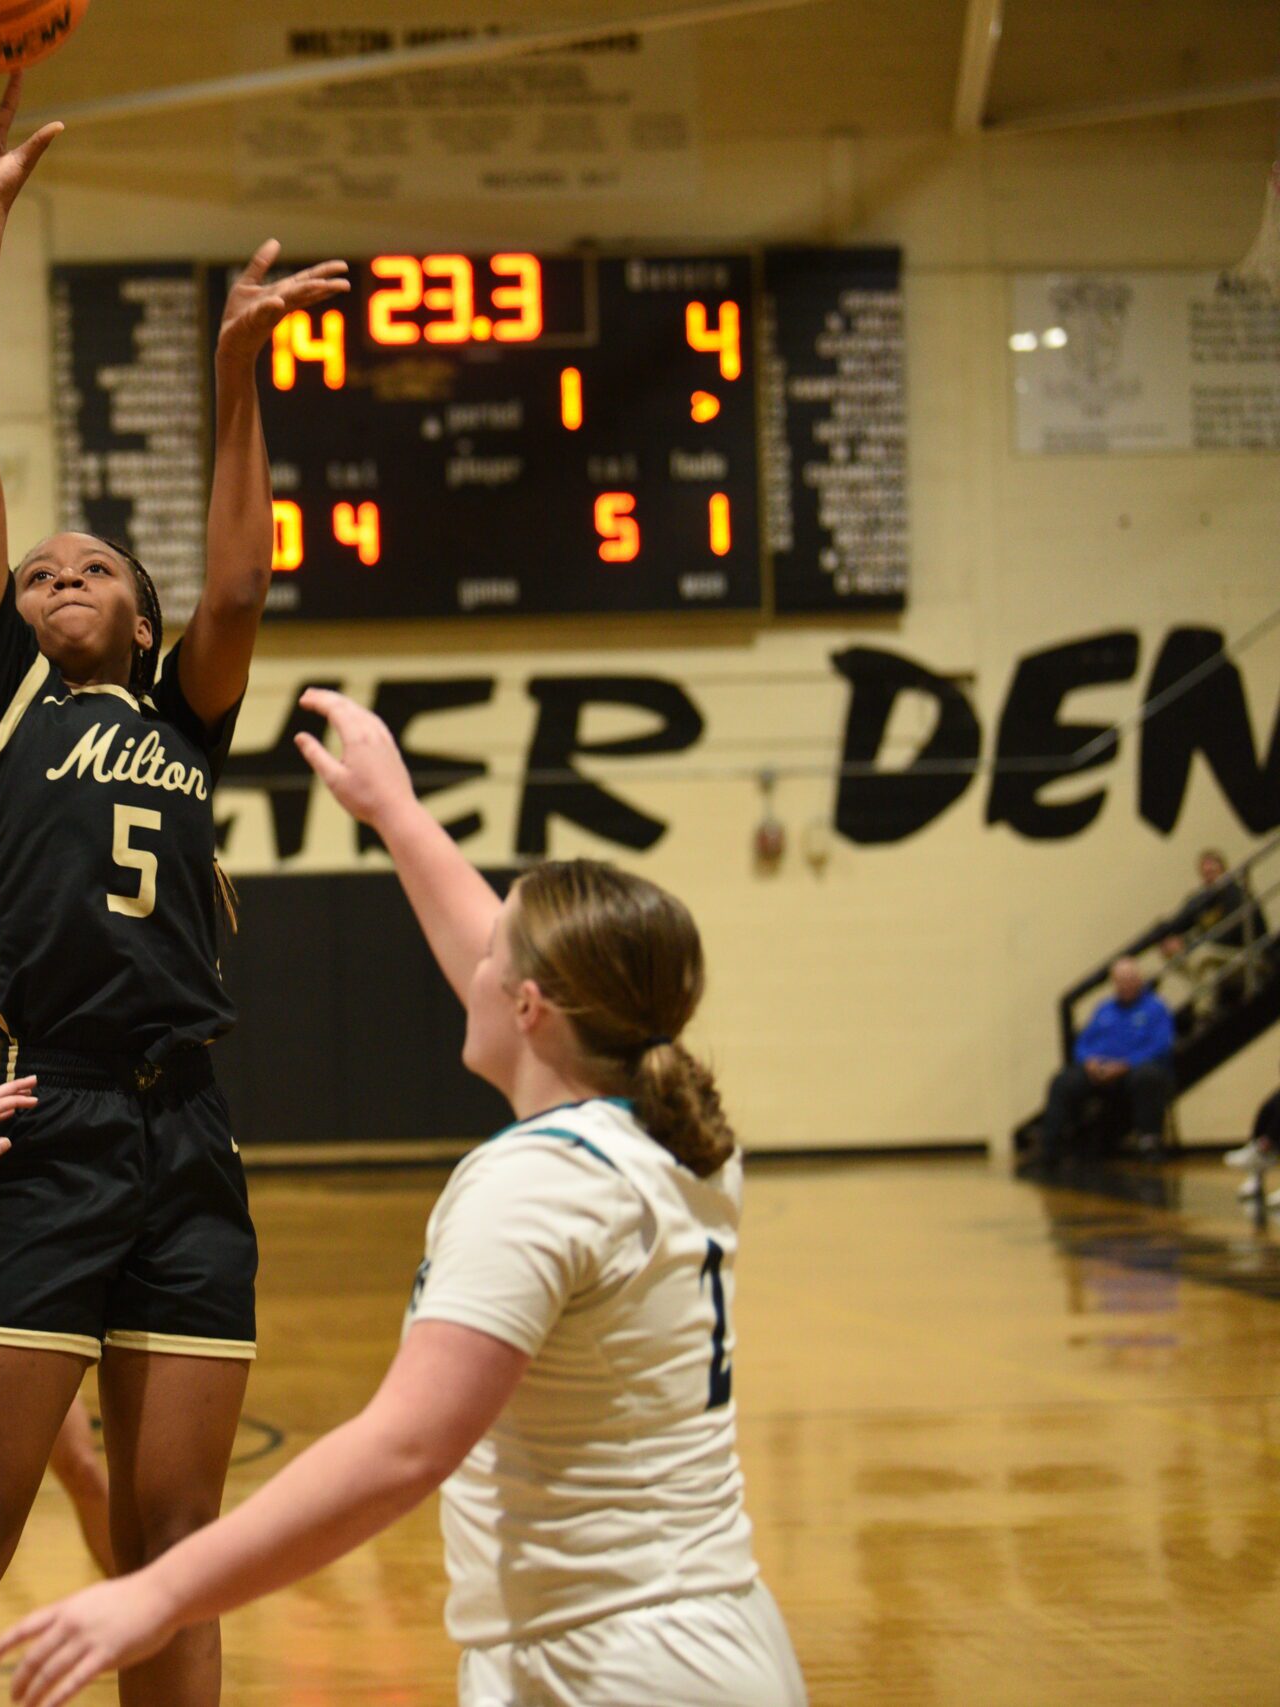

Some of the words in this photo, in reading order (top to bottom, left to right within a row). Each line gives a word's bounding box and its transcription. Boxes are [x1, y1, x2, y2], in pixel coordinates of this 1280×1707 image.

[369, 253, 542, 345] 23.3
[272, 309, 345, 391] 14
[686, 301, 741, 381] 4
[561, 367, 582, 429] 1
[332, 501, 380, 566] 4
[594, 492, 640, 563] 5
[708, 492, 731, 556] 1
[46, 722, 208, 801] Milton
[830, 627, 1280, 845] DEN
[106, 803, 162, 918] 5
